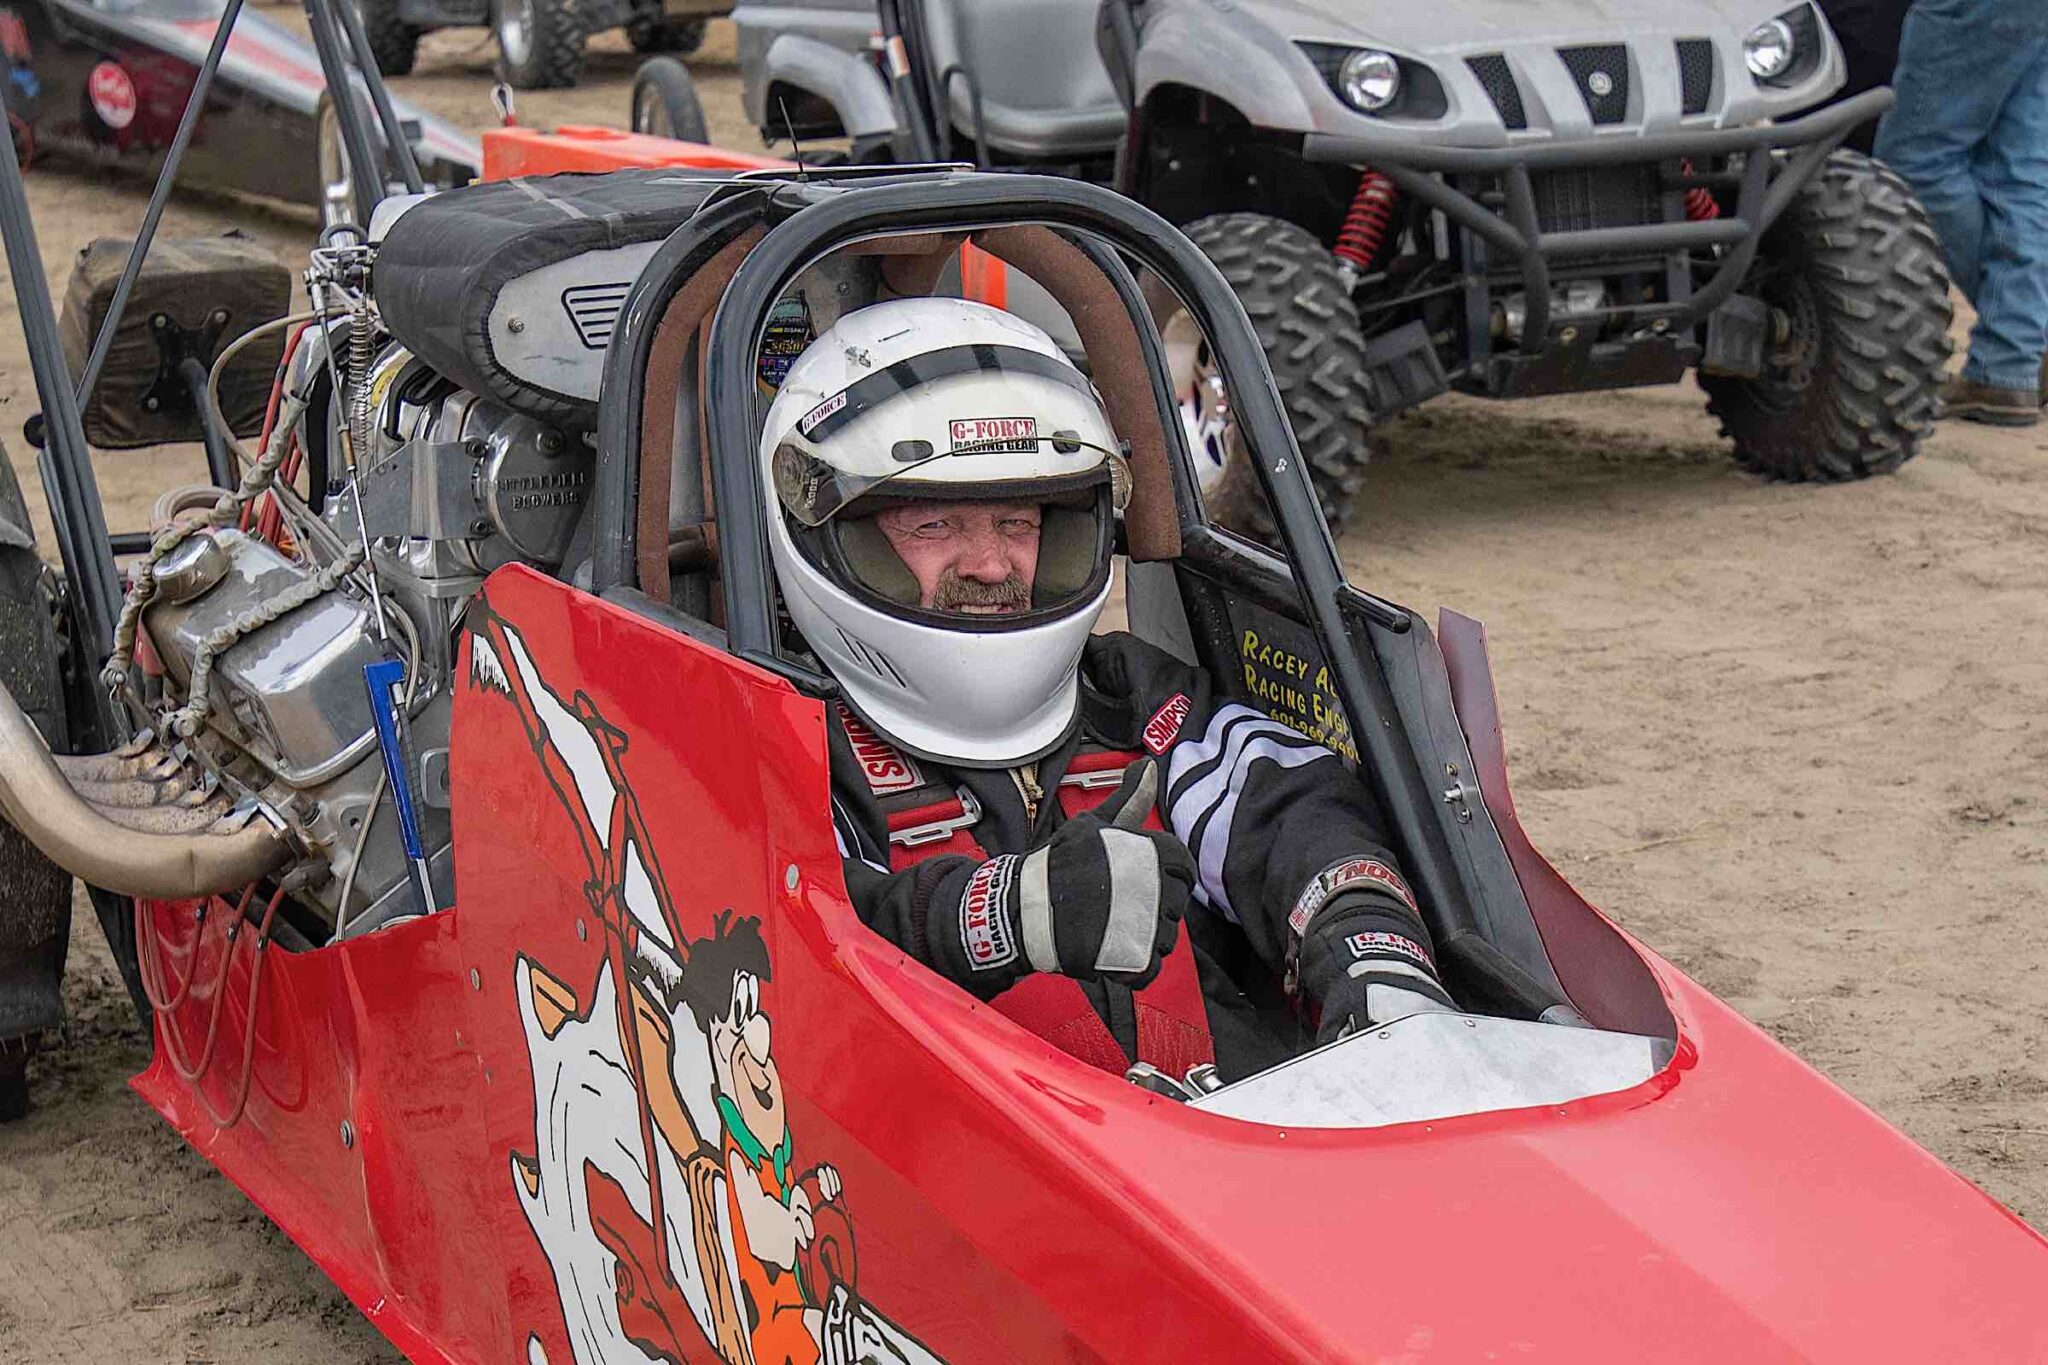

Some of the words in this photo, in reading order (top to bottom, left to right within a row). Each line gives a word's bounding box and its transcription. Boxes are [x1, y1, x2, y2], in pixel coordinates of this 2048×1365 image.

[803, 395, 845, 429] G-FORCE
[953, 420, 1034, 439] G-FORCE
[954, 438, 1004, 453] RACING
[1006, 437, 1036, 451] GEAR
[1244, 663, 1307, 715] RACING
[988, 890, 1006, 954] RACING
